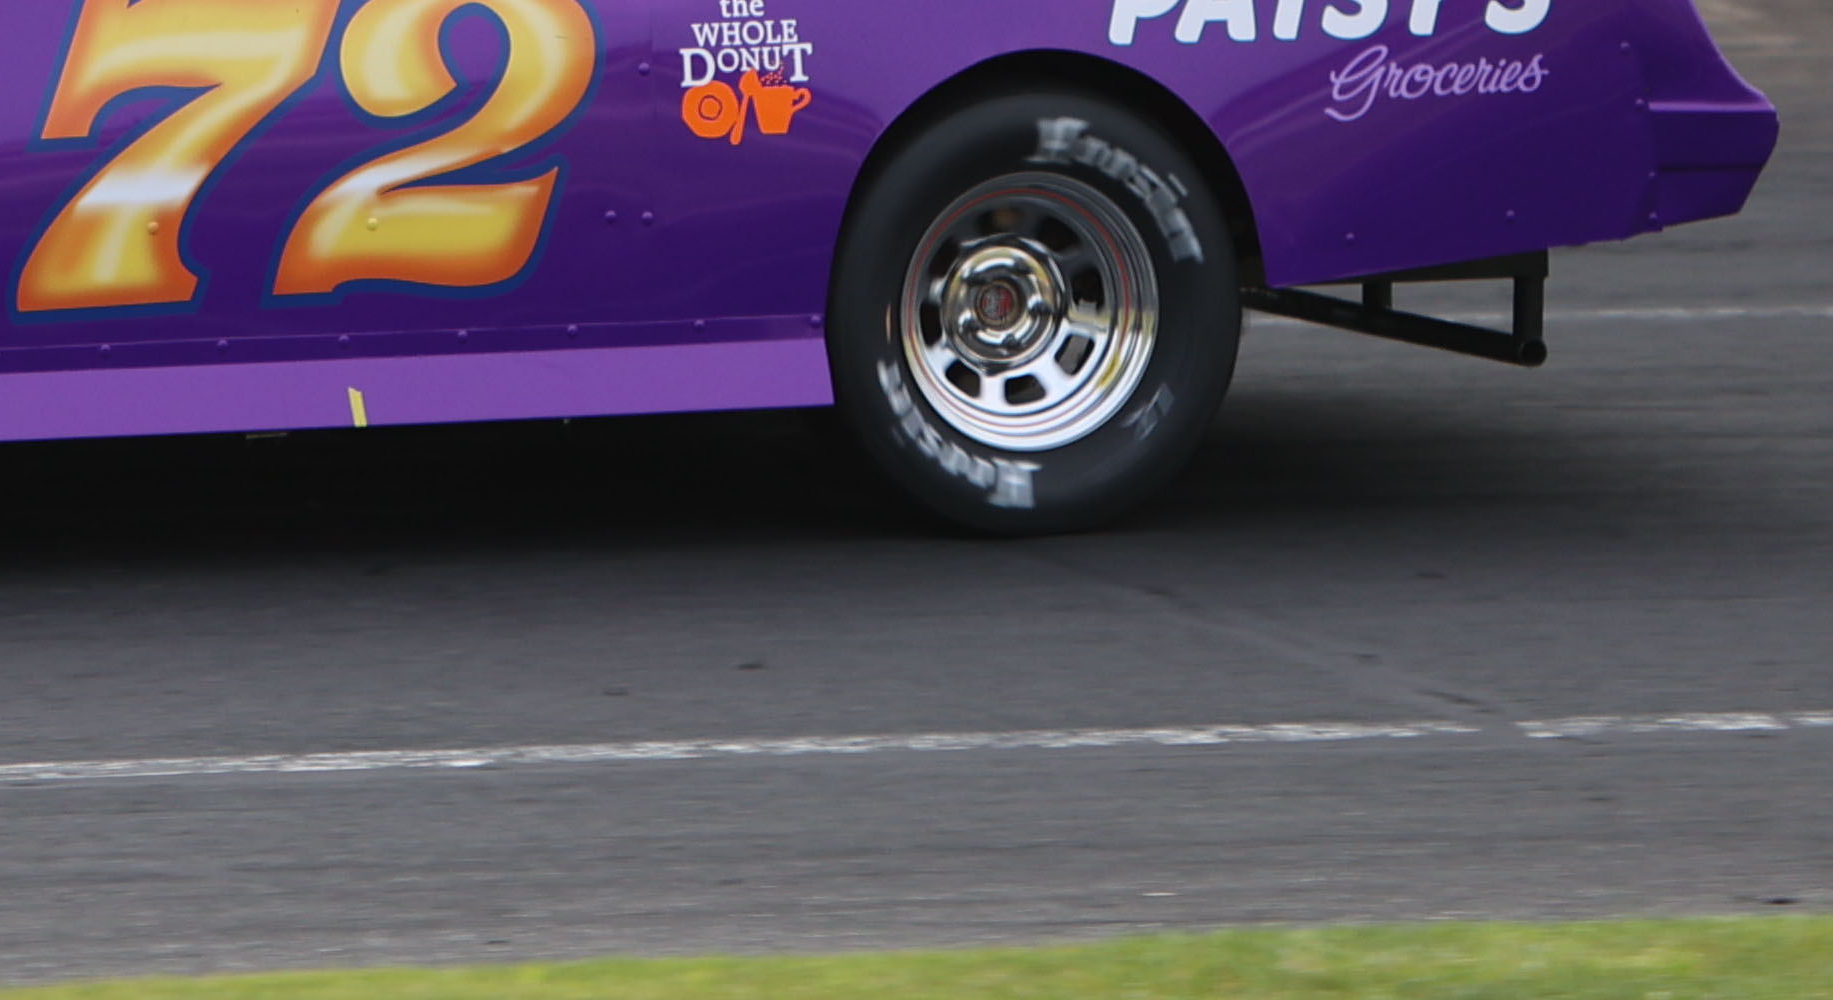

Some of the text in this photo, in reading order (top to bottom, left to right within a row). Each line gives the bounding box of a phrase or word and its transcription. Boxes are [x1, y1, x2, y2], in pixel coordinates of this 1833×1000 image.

[690, 18, 799, 48] WHOLE
[679, 42, 813, 87] DONUT
[1324, 44, 1549, 122] Groceries
